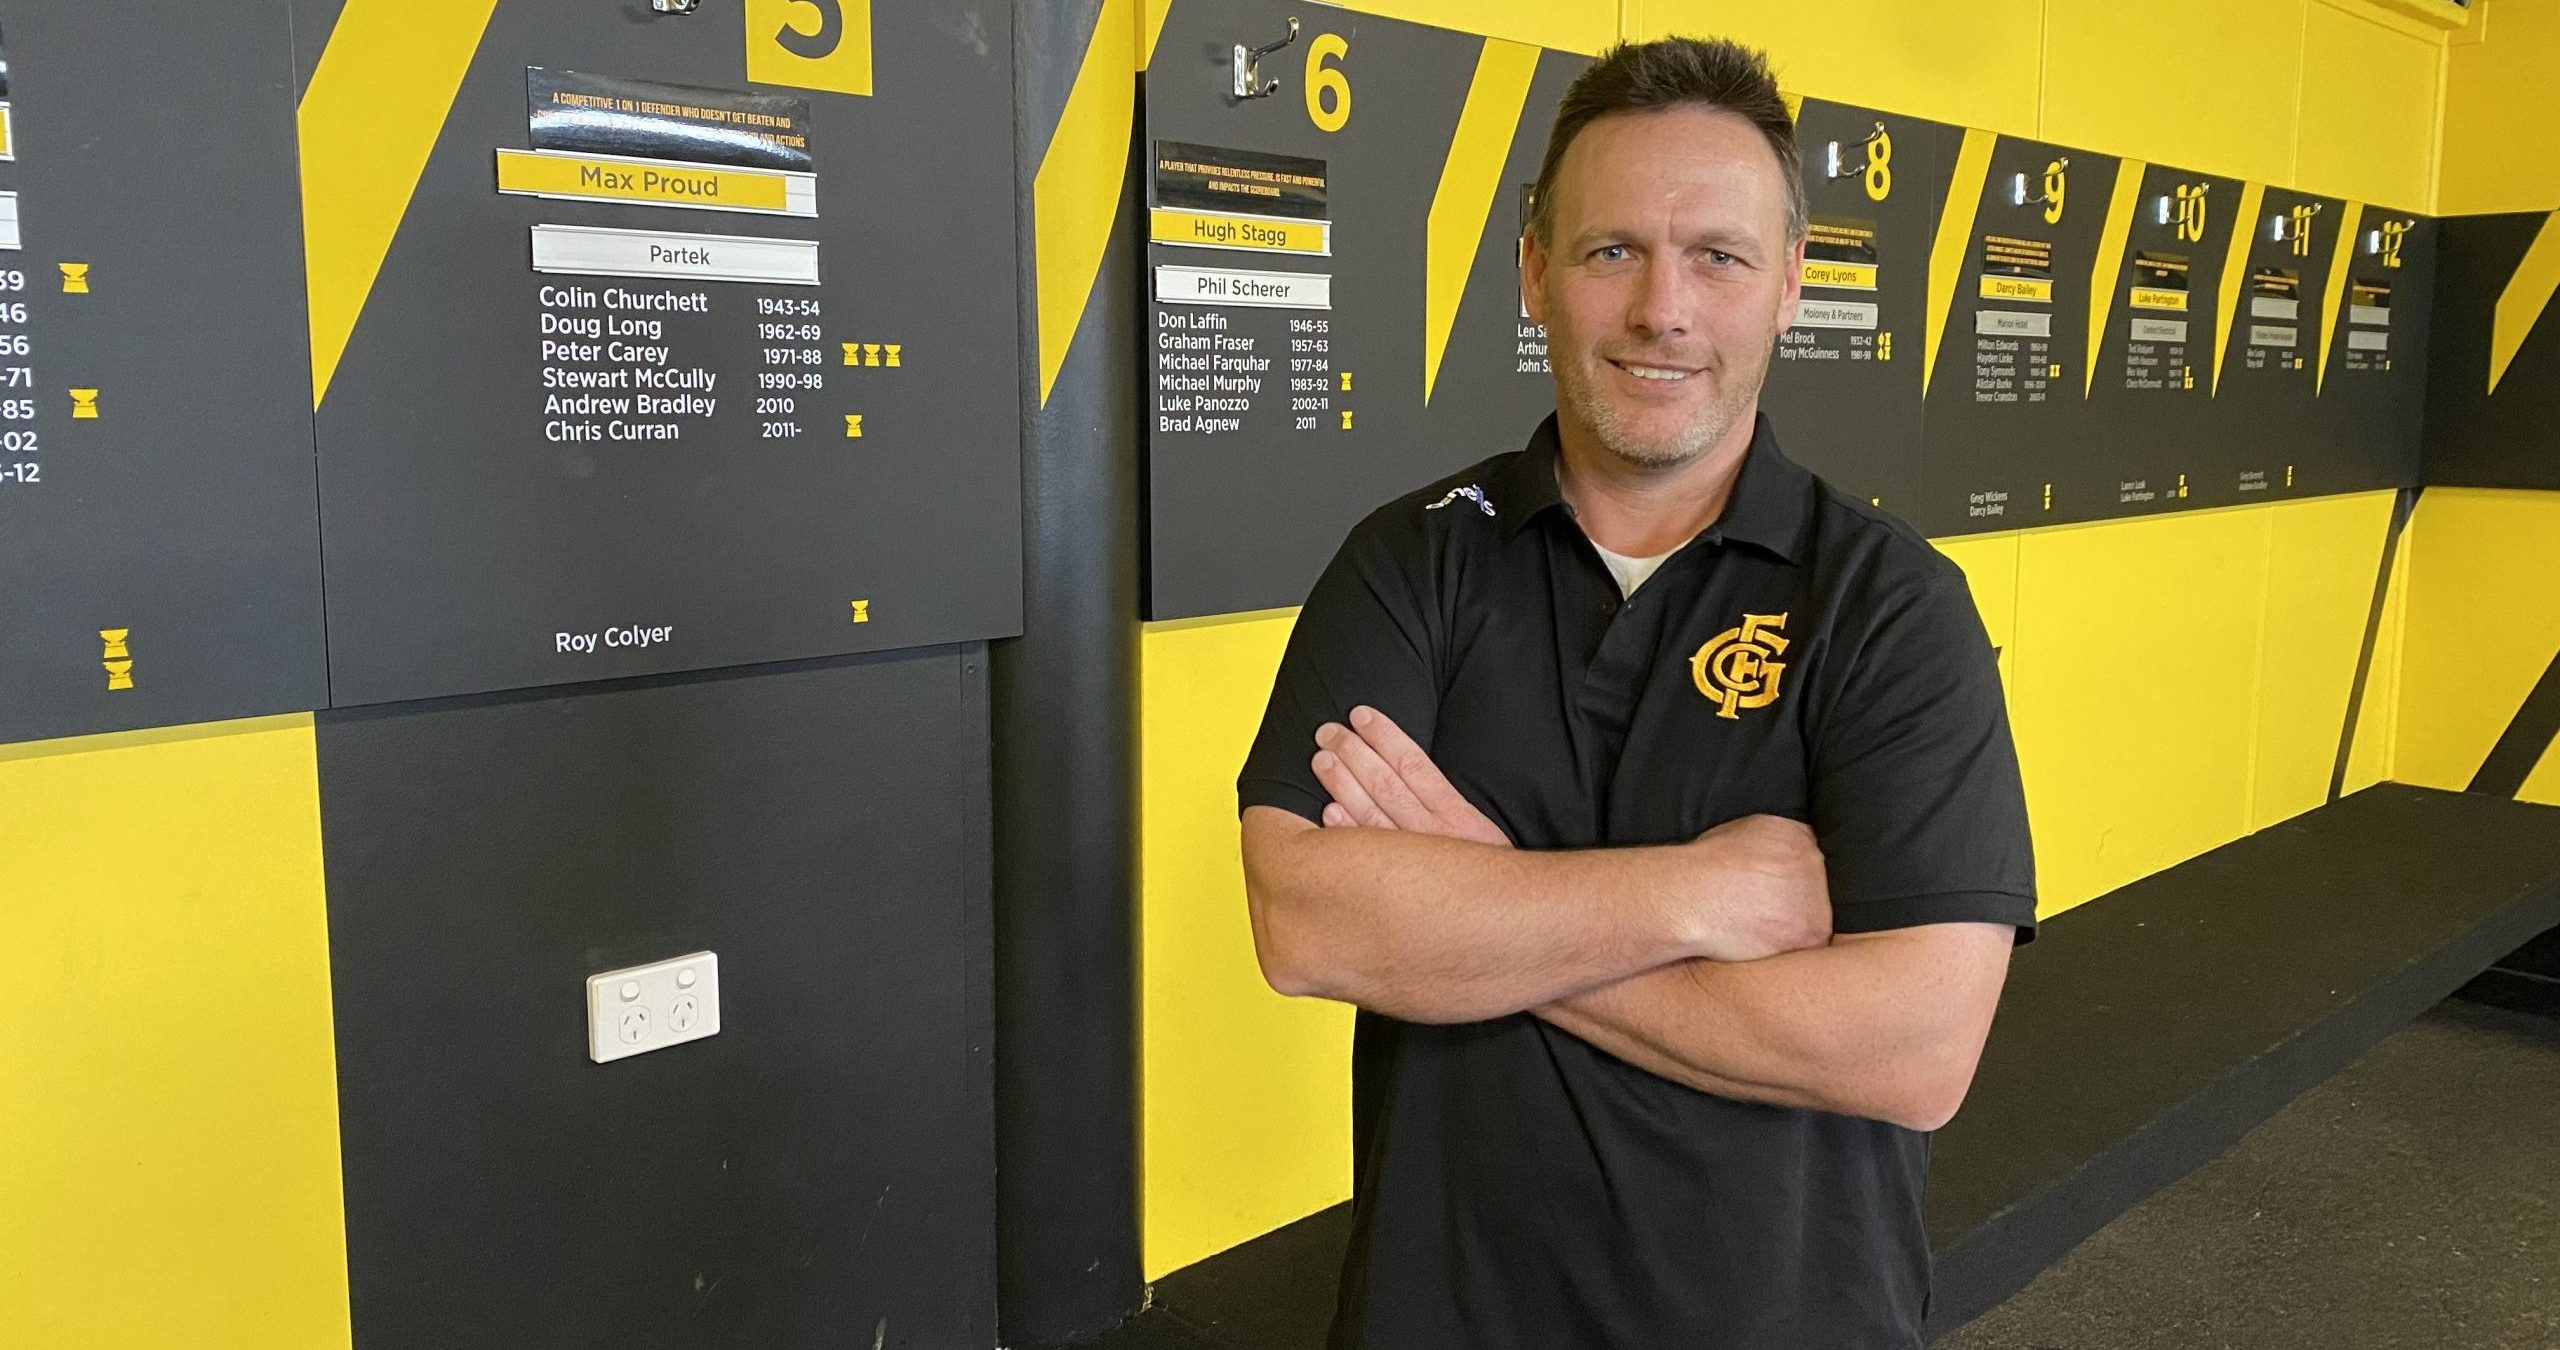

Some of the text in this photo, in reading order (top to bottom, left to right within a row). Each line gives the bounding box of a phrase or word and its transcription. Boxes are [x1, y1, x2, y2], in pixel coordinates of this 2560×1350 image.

[1304, 33, 1351, 132] 6
[552, 92, 790, 128] A COMPETITIVE 1 ON 1 DEFENDER WHO DOESN'T GET BEATEN AND
[776, 134, 804, 148] ACTIONS
[1164, 160, 1184, 172] PLAYER
[1184, 162, 1198, 172] THAT
[1865, 130, 1892, 202] 8
[580, 165, 718, 198] Max Proud
[2044, 161, 2065, 224] 9
[2176, 184, 2206, 243] 10
[1194, 219, 1286, 246] Hugh Stagg
[2293, 204, 2311, 256] 11
[2384, 220, 2402, 268] 12
[650, 244, 710, 266] Partek
[1805, 266, 1857, 282] Corey Lyons
[1198, 277, 1290, 298] Phil Scherer
[1996, 282, 2037, 298] Darcy Bailey
[539, 286, 820, 316] Colin Churchett 1943-54
[1158, 312, 1328, 332] Don Laffin 1946-55
[1804, 308, 1863, 322] Moloney & Partners
[540, 314, 821, 342] Doug Long 1962-69
[1518, 324, 1534, 338] Len
[1780, 332, 1793, 344] Mel
[1794, 332, 1816, 344] Brock
[0, 334, 30, 356] 56
[1158, 332, 1328, 352] Graham Fraser 1957-63
[1517, 340, 1548, 356] Arthur
[542, 340, 822, 366] Peter Carey 1971-88
[1780, 346, 1796, 360] Tony
[1798, 346, 1840, 360] McGuinness
[1159, 354, 1328, 374] Michael Farquhar 1977-84
[1516, 358, 1540, 374] John
[543, 366, 822, 392] Stewart McCully 1990-98
[1159, 374, 1328, 394] Michael Murphy 1983-92
[0, 399, 35, 420] 85
[545, 394, 794, 419] Andrew Bradley 2010
[1160, 395, 1328, 412] Luke Panozzo 2002-11
[545, 419, 802, 442] Chris Curran 2011-
[1160, 416, 1316, 434] Brad Agnew 2011
[0, 431, 38, 451] 02
[555, 624, 673, 654] Roy Colyer
